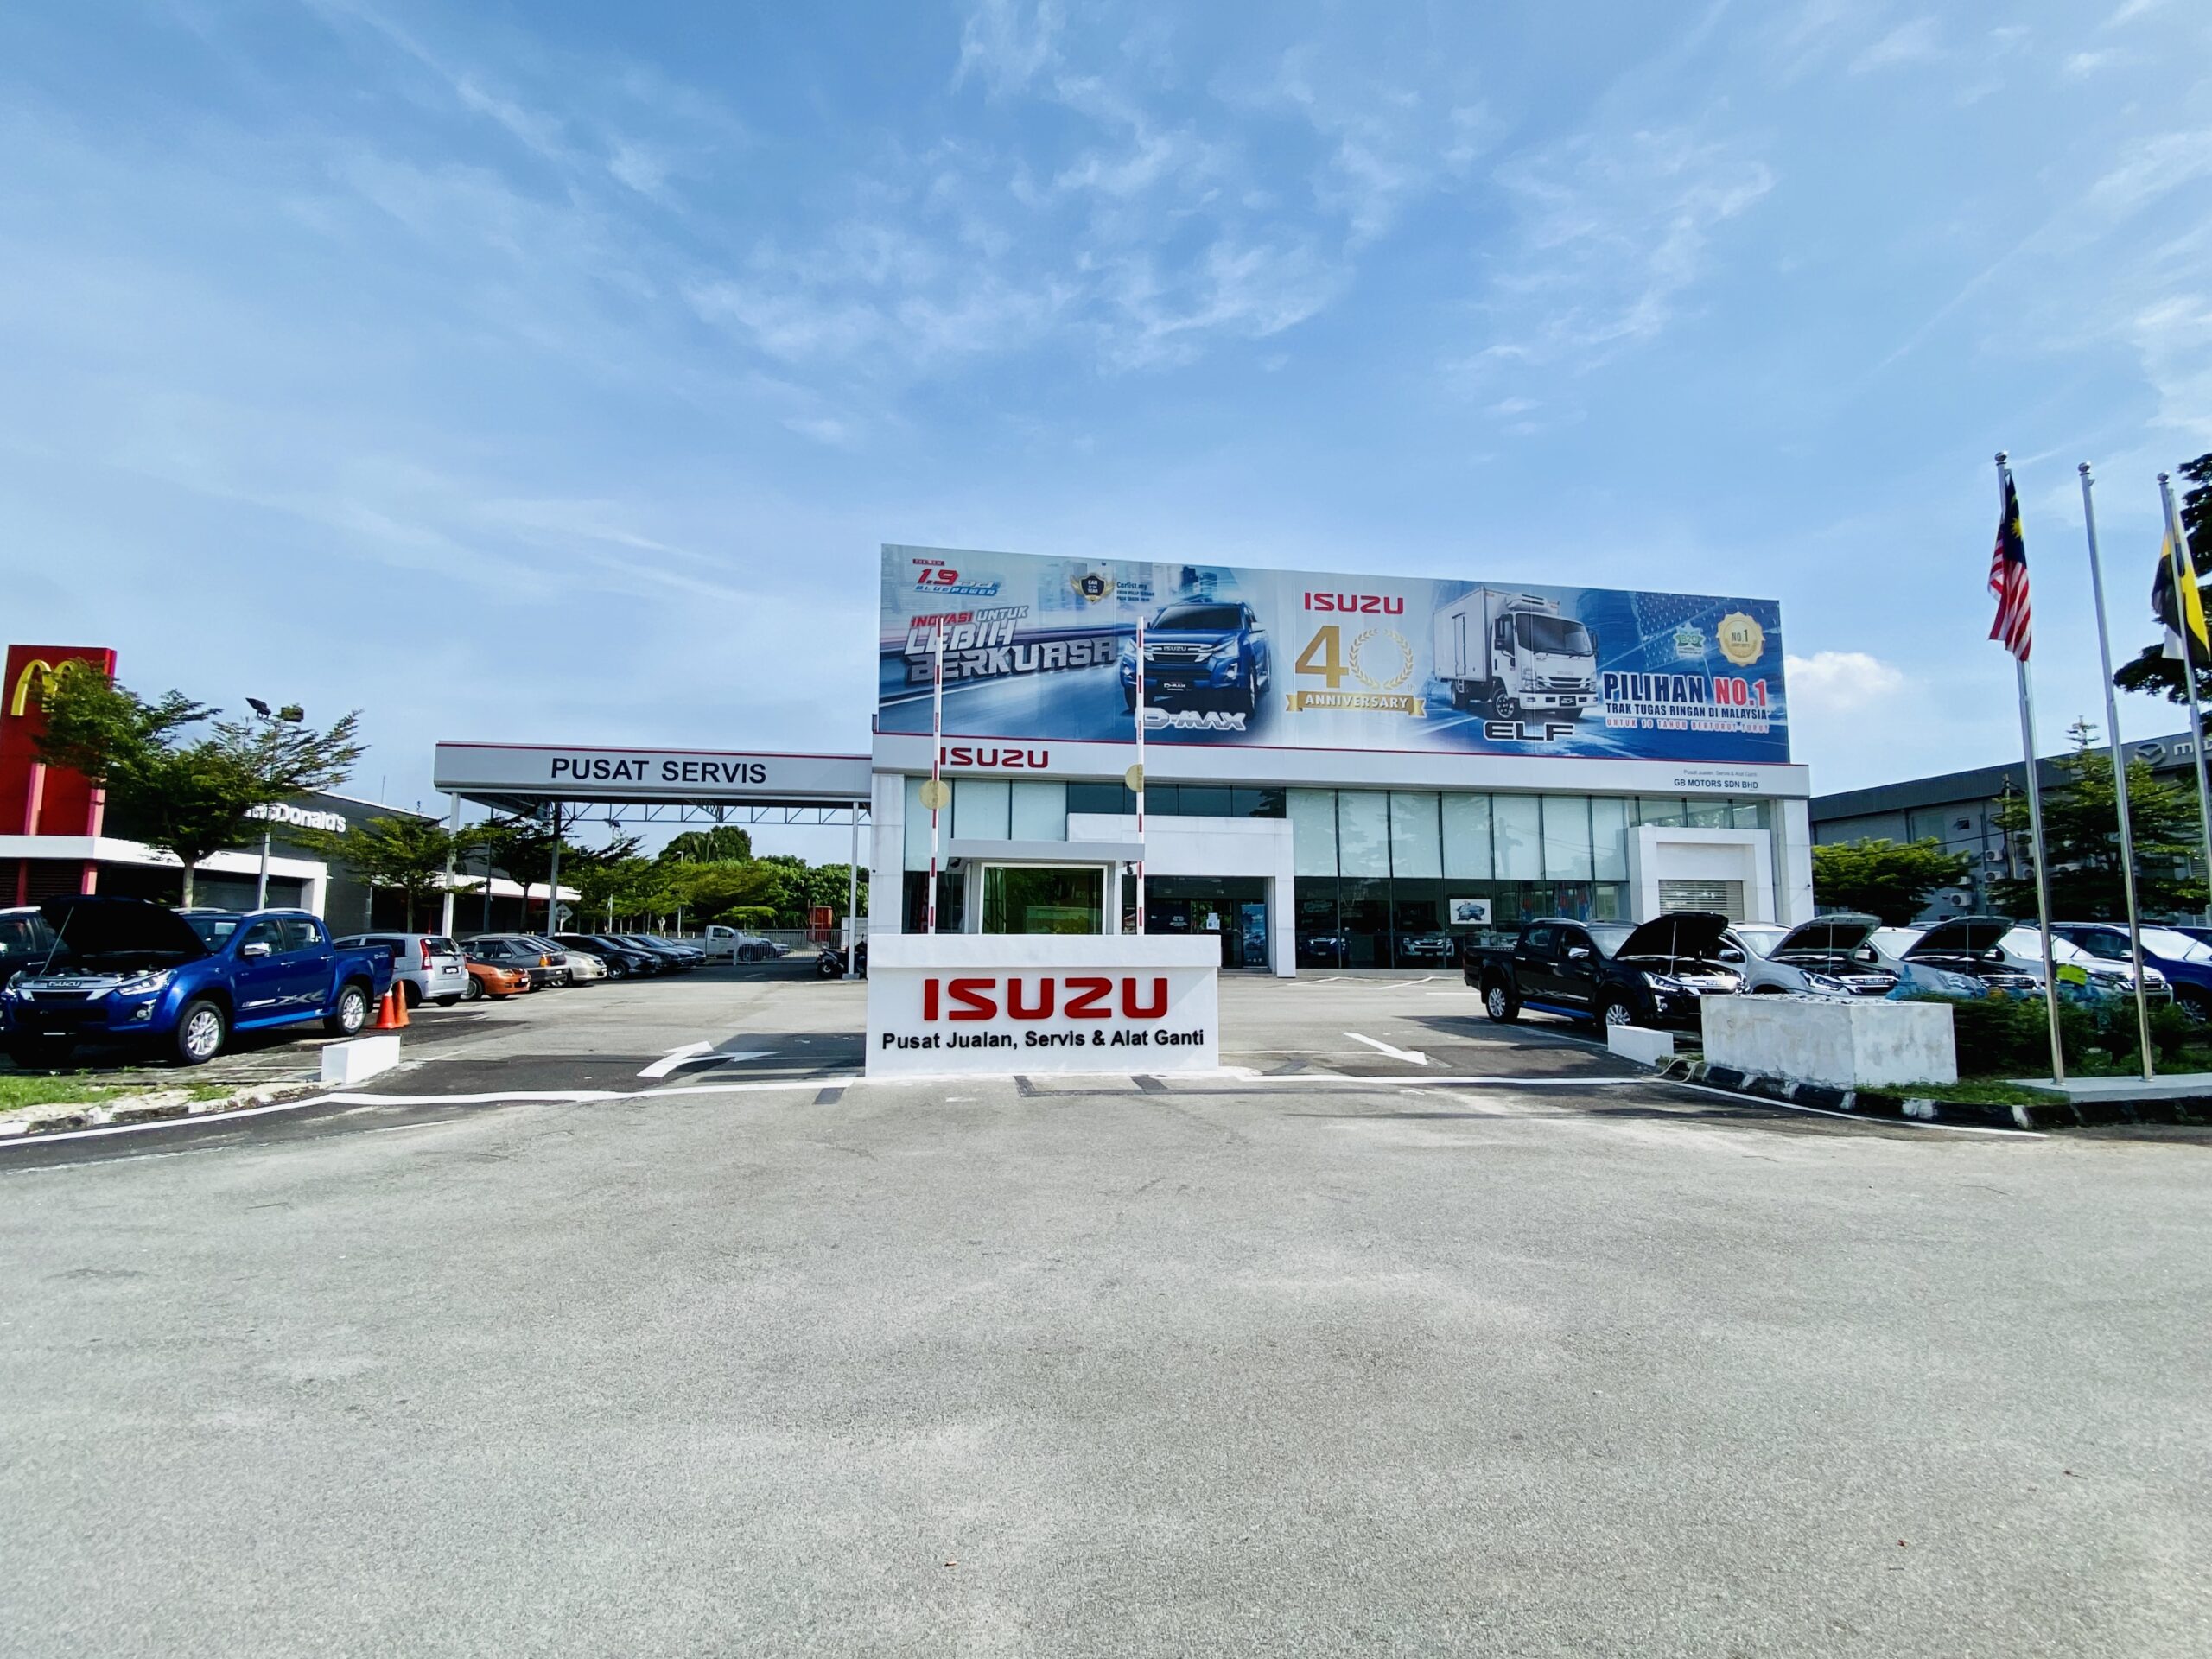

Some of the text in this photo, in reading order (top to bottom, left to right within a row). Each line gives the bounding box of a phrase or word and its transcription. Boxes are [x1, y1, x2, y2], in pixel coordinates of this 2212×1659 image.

[917, 569, 958, 585] 1.9
[976, 605, 1029, 622] UNTUK
[1305, 593, 1403, 615] ISUZU
[904, 619, 1018, 655] LEBIH
[1732, 629, 1748, 642] NO.1
[906, 636, 1117, 684] BERKUASA
[1603, 673, 1766, 707] PILIHAN NO.1
[1305, 694, 1408, 709] ANNIVERSARY
[1606, 703, 1631, 714] TRAK
[1635, 704, 1667, 715] TUGAS
[1669, 706, 1706, 717] RINGAN
[1709, 708, 1719, 717] DI
[1135, 707, 1247, 731] D-MAX
[1657, 720, 1687, 728] TAHUN
[1484, 721, 1575, 741] ELF
[940, 747, 1048, 768] ISUZU
[551, 758, 766, 784] PUSAT SERVIS
[924, 978, 1168, 1020] ISUZU
[882, 1029, 1205, 1051] Pusat Jualan, Servis & Alat Ganti
